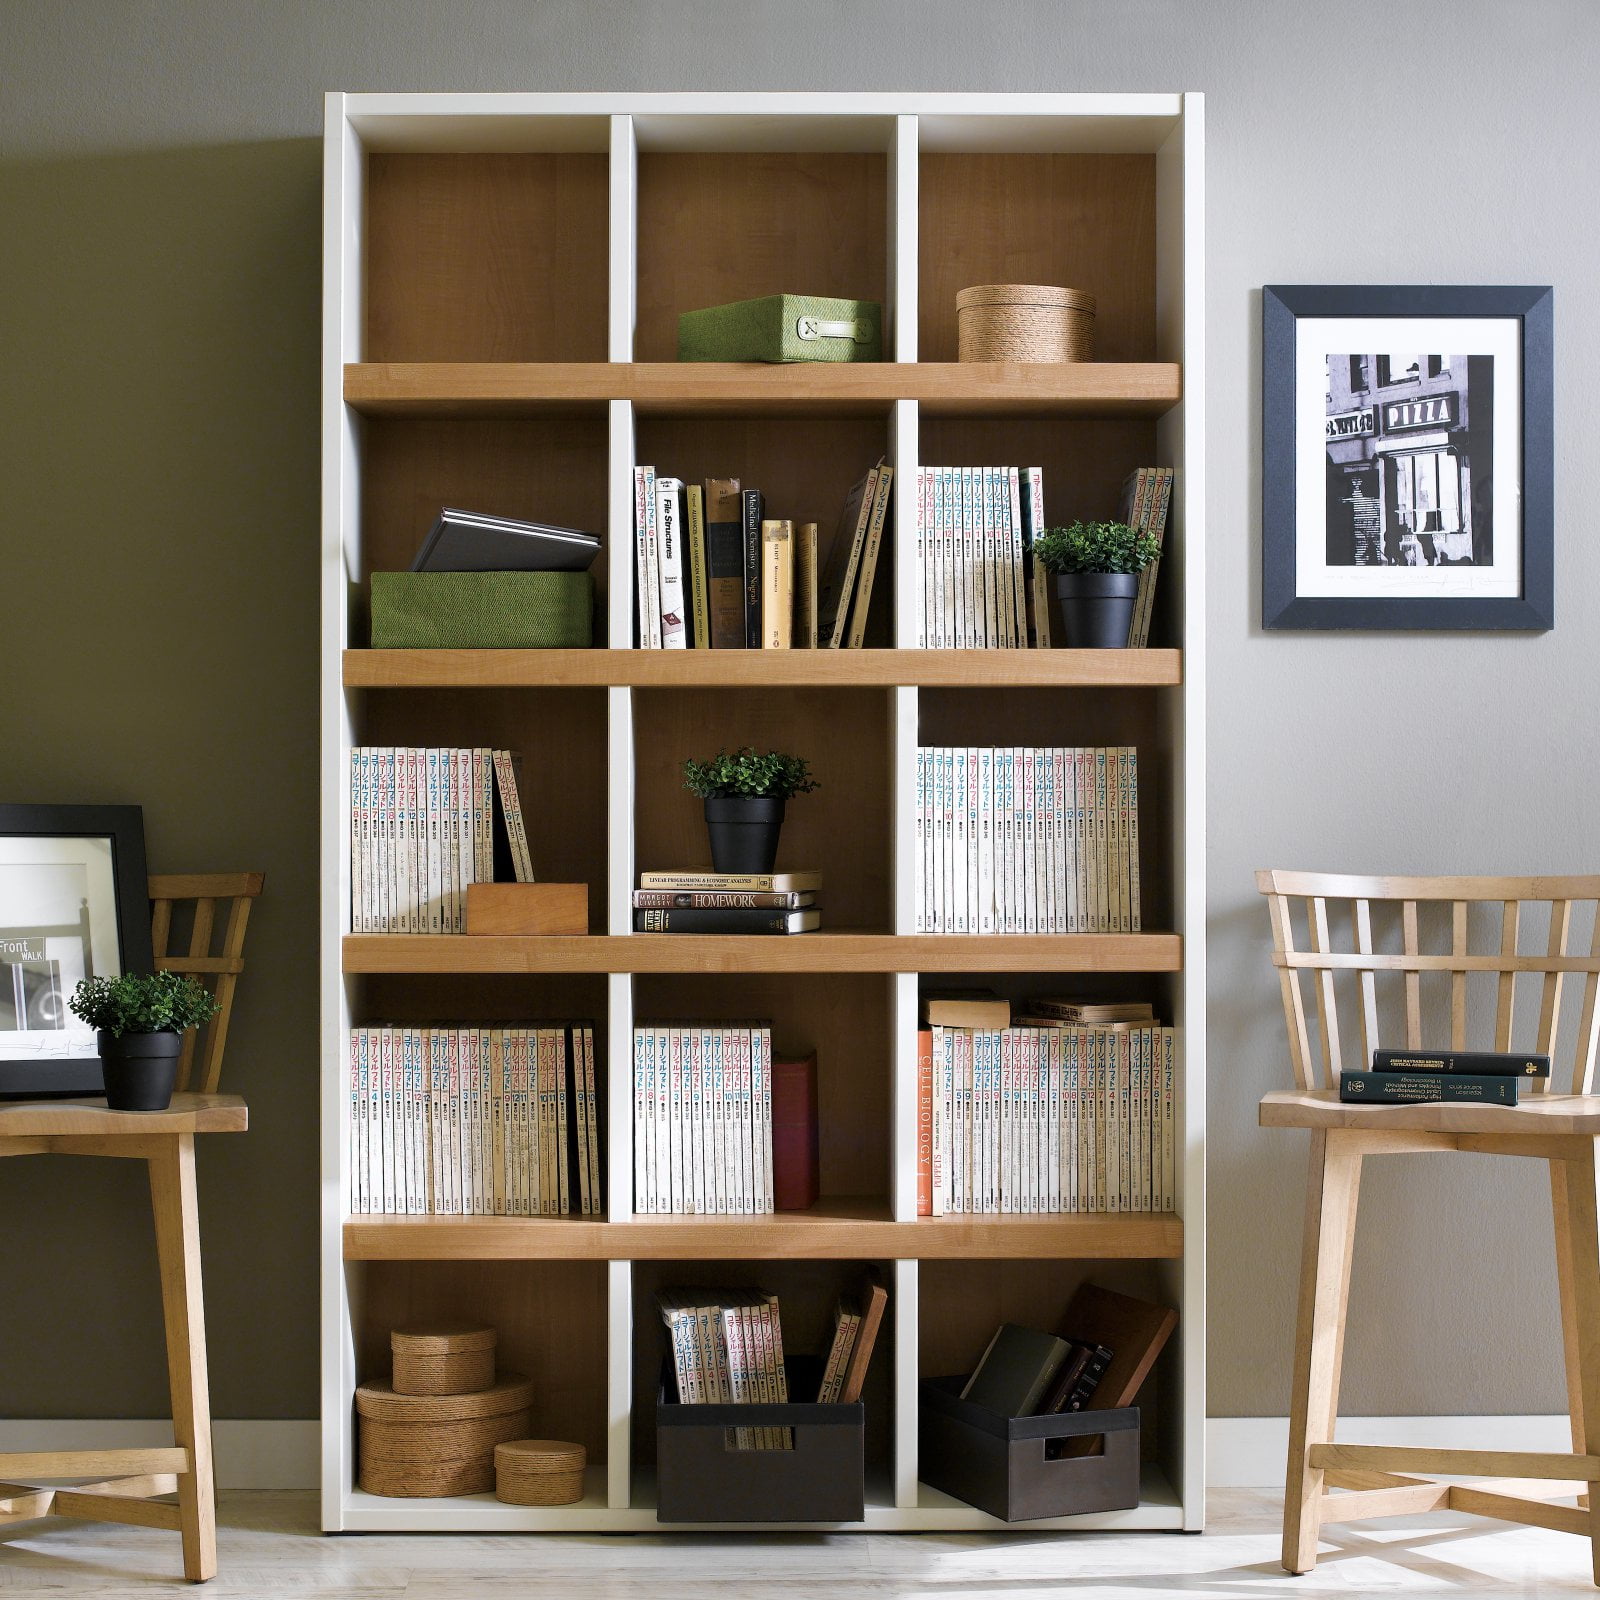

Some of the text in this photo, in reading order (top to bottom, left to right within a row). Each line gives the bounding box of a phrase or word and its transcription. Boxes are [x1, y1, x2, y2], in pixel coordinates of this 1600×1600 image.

[1388, 400, 1448, 426] PIZZA
[748, 531, 756, 569] Chemistry
[748, 576, 758, 606] Nogrady
[695, 895, 757, 908] HOMEWORK
[0, 940, 28, 952] Front
[22, 952, 42, 960] WALK
[920, 1056, 931, 1164] CELL BIOLOGY
